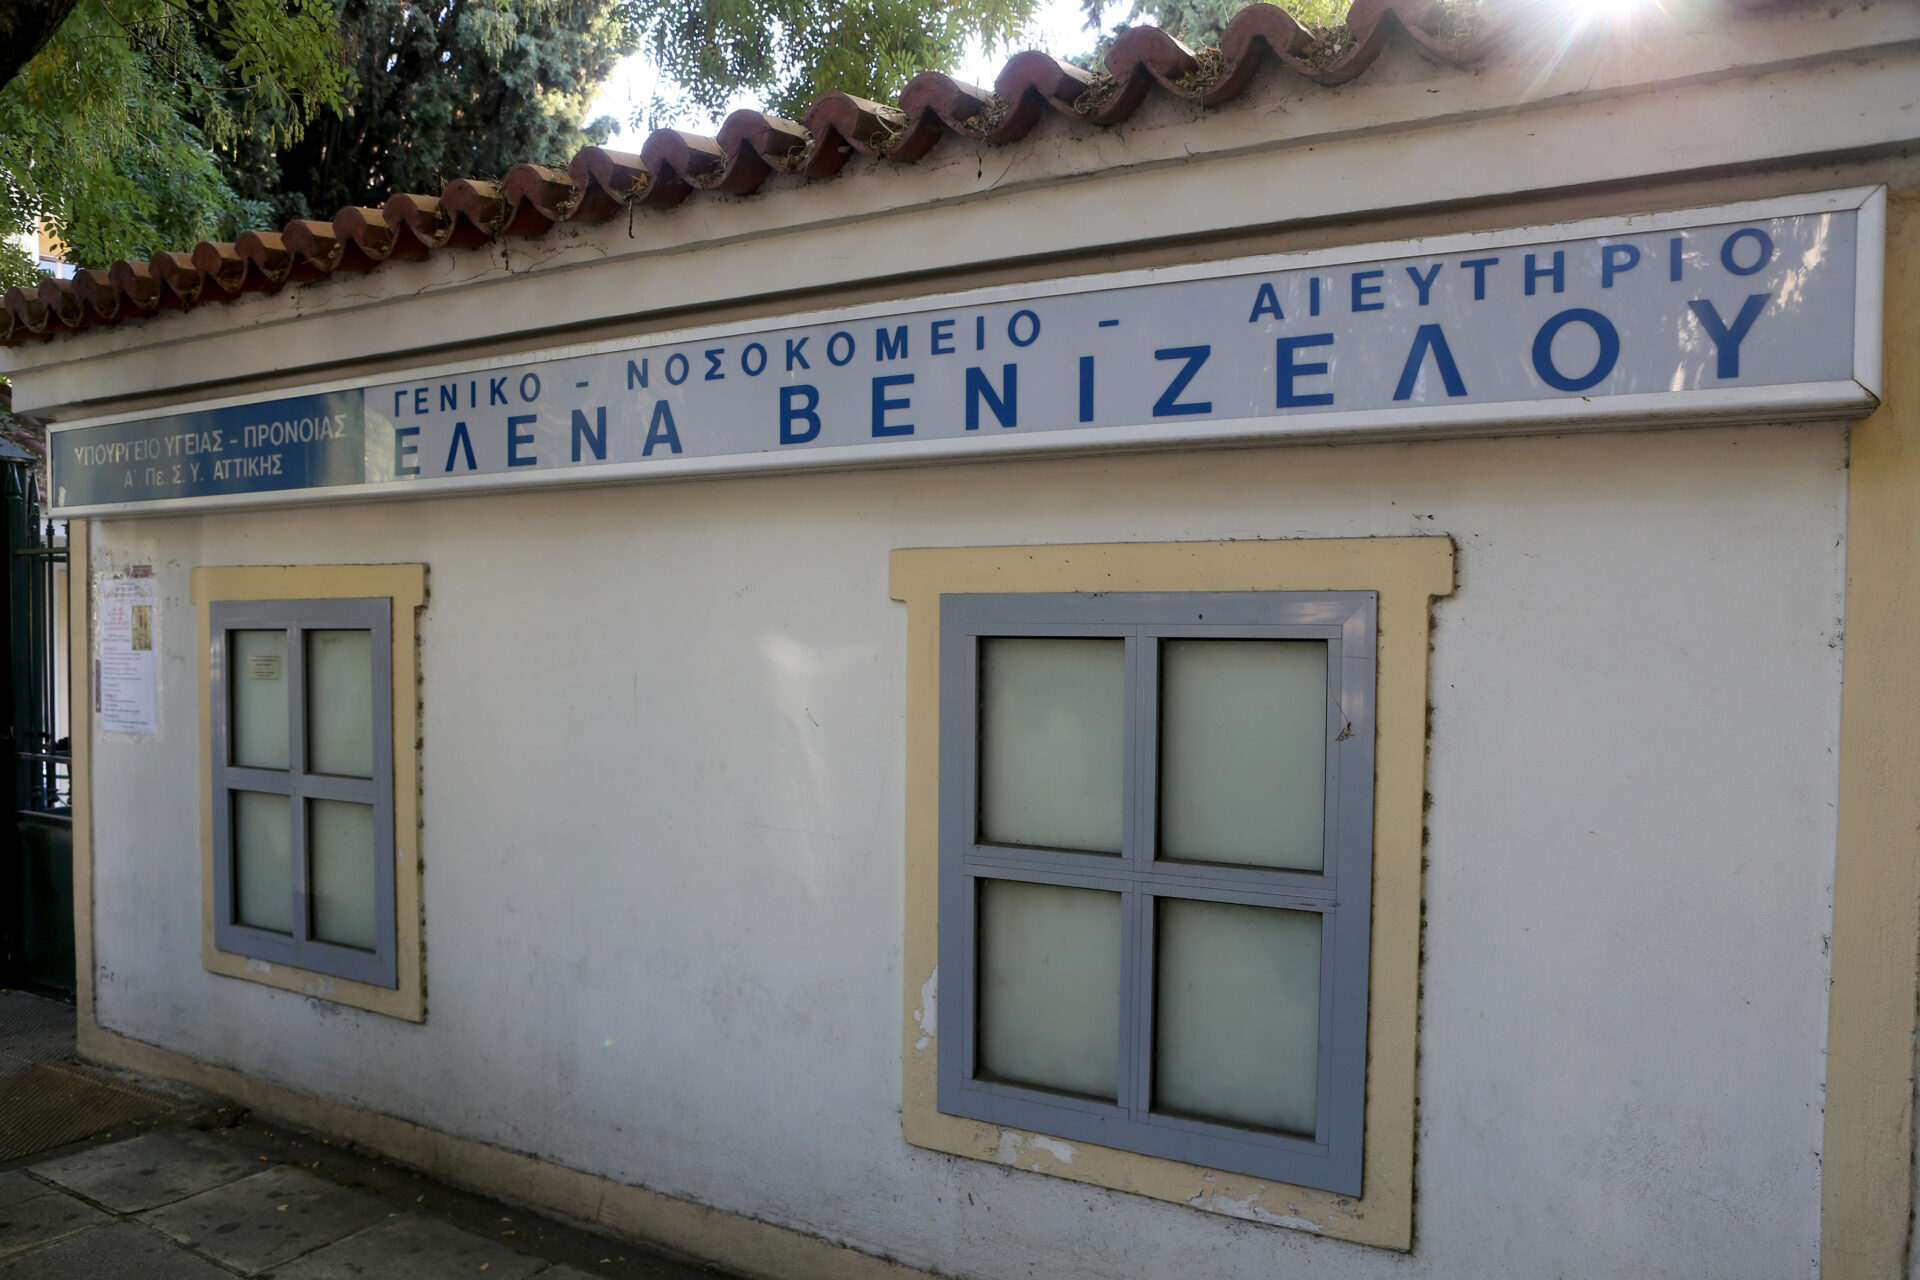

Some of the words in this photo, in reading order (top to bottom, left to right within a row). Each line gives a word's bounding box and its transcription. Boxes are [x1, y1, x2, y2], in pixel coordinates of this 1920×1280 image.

[395, 372, 541, 417] ΓΕΝΙΚΟ
[627, 309, 1041, 391] ΝΟΣΟΚΟΜΕΙΟ
[1248, 227, 1774, 323] ΑΙΕΥΤΗΡΙΟ
[75, 438, 160, 466] ΥΠΟΥΡΓΕΙΟ
[164, 430, 223, 457] ΥΓΕΙΑΣ
[244, 414, 347, 449] ΠΡΟΝΟΙΑΣ
[395, 400, 683, 477] ΕΛΕΝΑ
[779, 293, 1772, 446] ΒΕΝΙΖΕΛΟΥ
[213, 453, 283, 480] ΑΤΤΙΚΗΣ
